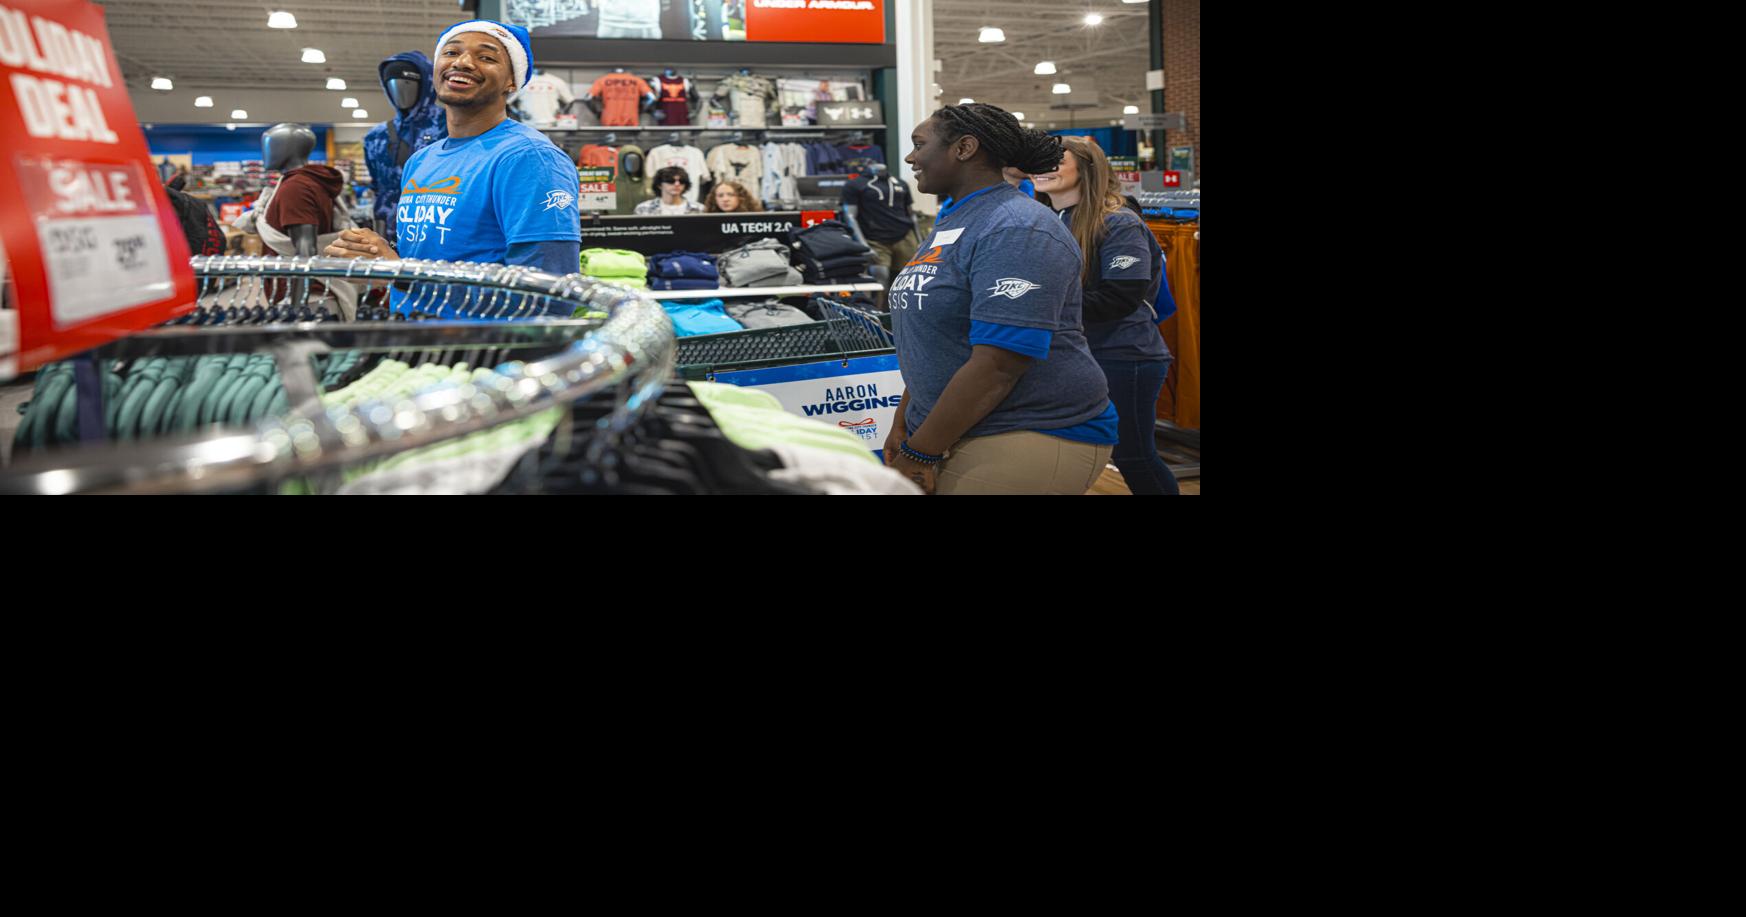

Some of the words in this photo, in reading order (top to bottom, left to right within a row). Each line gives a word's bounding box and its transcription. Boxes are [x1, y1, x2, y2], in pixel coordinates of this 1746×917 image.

[0, 6, 112, 88] OLIDAY
[9, 73, 119, 143] DEAL
[50, 167, 136, 212] SALE
[580, 183, 608, 192] SALE
[396, 205, 454, 225] OLIDAY
[721, 223, 739, 234] UA
[740, 222, 773, 233] TECH
[825, 383, 878, 402] AARON
[801, 395, 902, 417] WIGGINS
